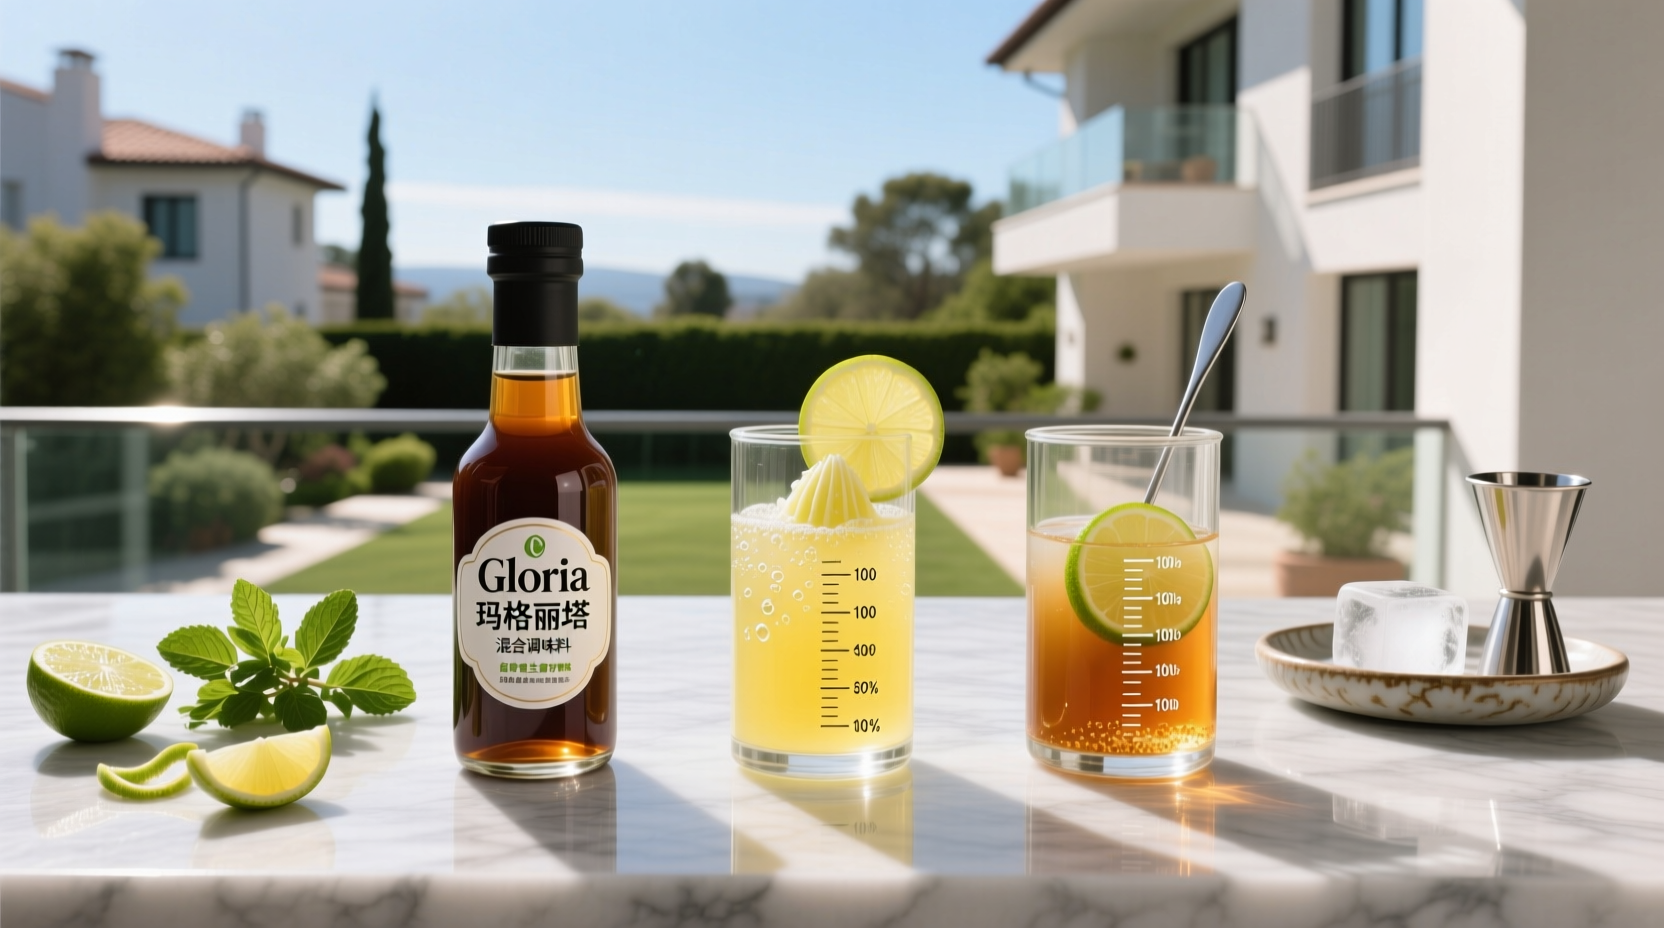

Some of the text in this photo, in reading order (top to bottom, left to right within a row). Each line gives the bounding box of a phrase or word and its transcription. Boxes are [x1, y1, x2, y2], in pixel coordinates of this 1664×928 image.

[478, 556, 591, 593] Gloria
[854, 567, 877, 581] 100
[475, 599, 590, 631] 玛格丽塔
[853, 605, 877, 619] 100
